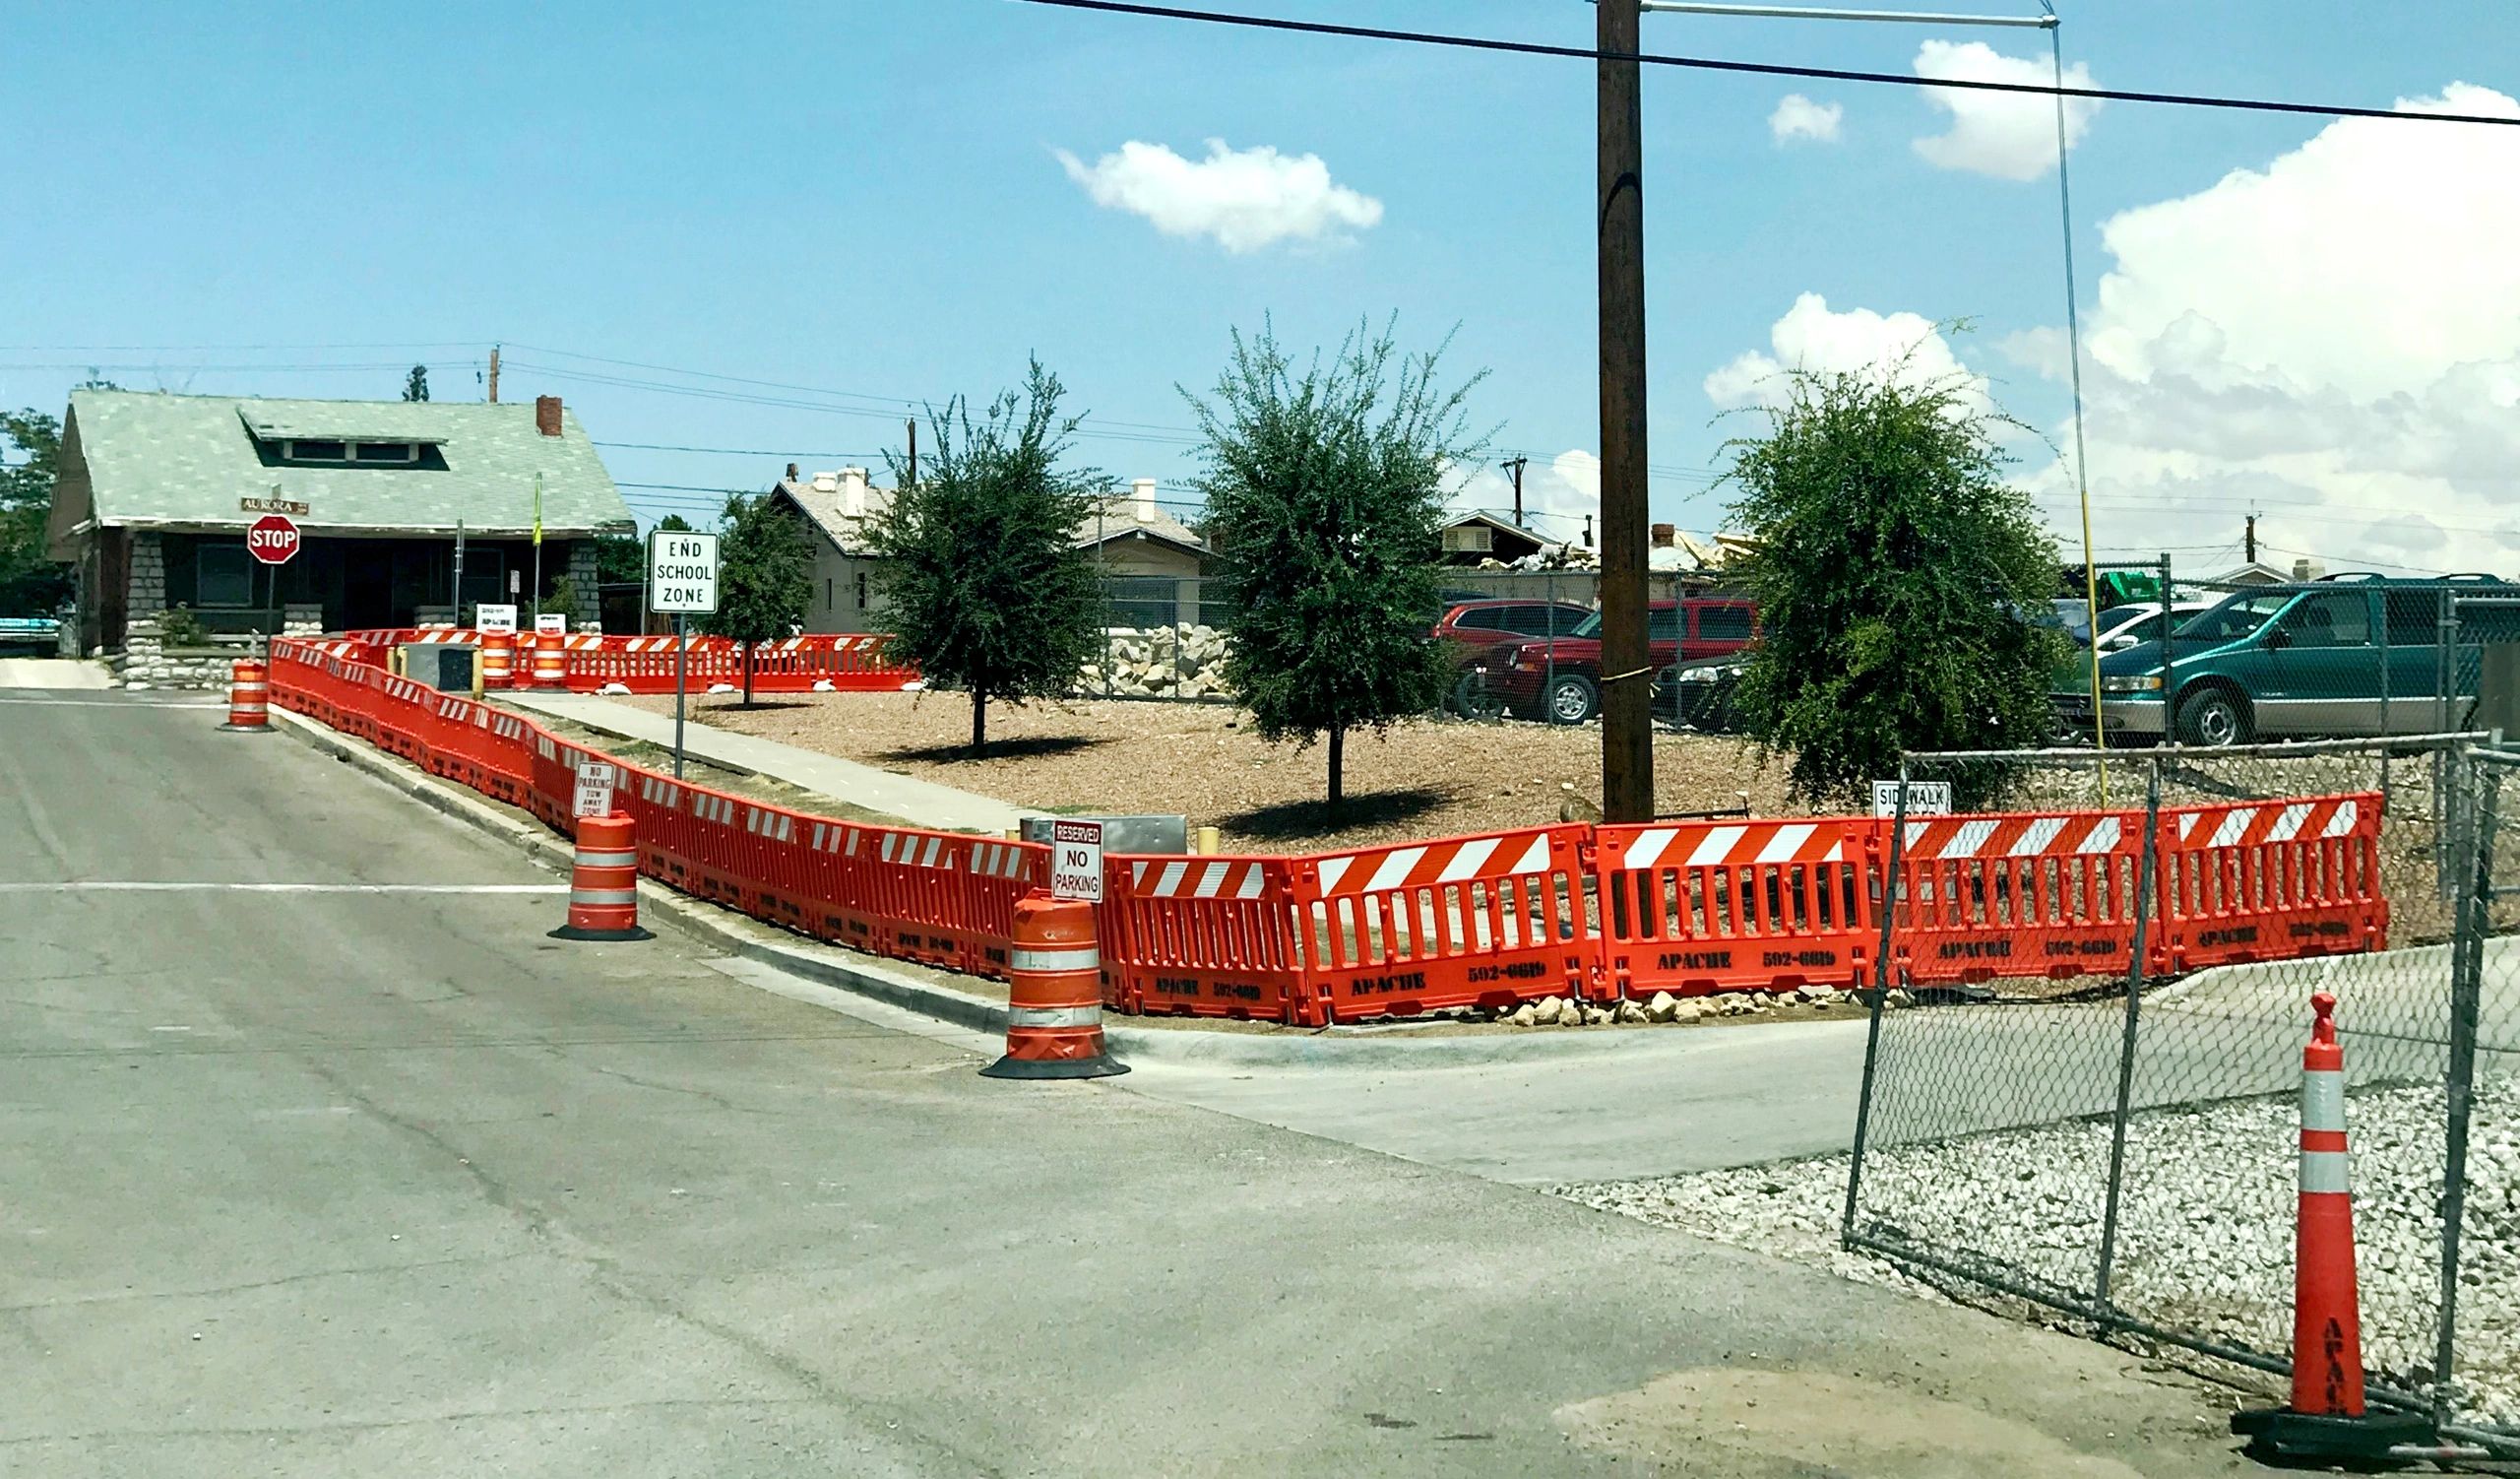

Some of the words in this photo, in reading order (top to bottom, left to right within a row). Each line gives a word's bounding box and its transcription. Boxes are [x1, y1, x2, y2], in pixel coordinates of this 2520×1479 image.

[243, 498, 292, 512] AURORA
[251, 529, 296, 548] STOP
[669, 542, 702, 557] END
[657, 564, 713, 580] SCHOOL
[662, 587, 704, 603] ZONE
[590, 766, 601, 777] NO
[577, 777, 611, 789] PARKING
[1880, 789, 1944, 805] SIDWALK
[1056, 824, 1100, 843] RESERVED
[1066, 850, 1089, 868] NO
[1054, 873, 1099, 893] PARKING
[1657, 951, 1732, 971] APACHE
[1351, 971, 1426, 997] APACHE
